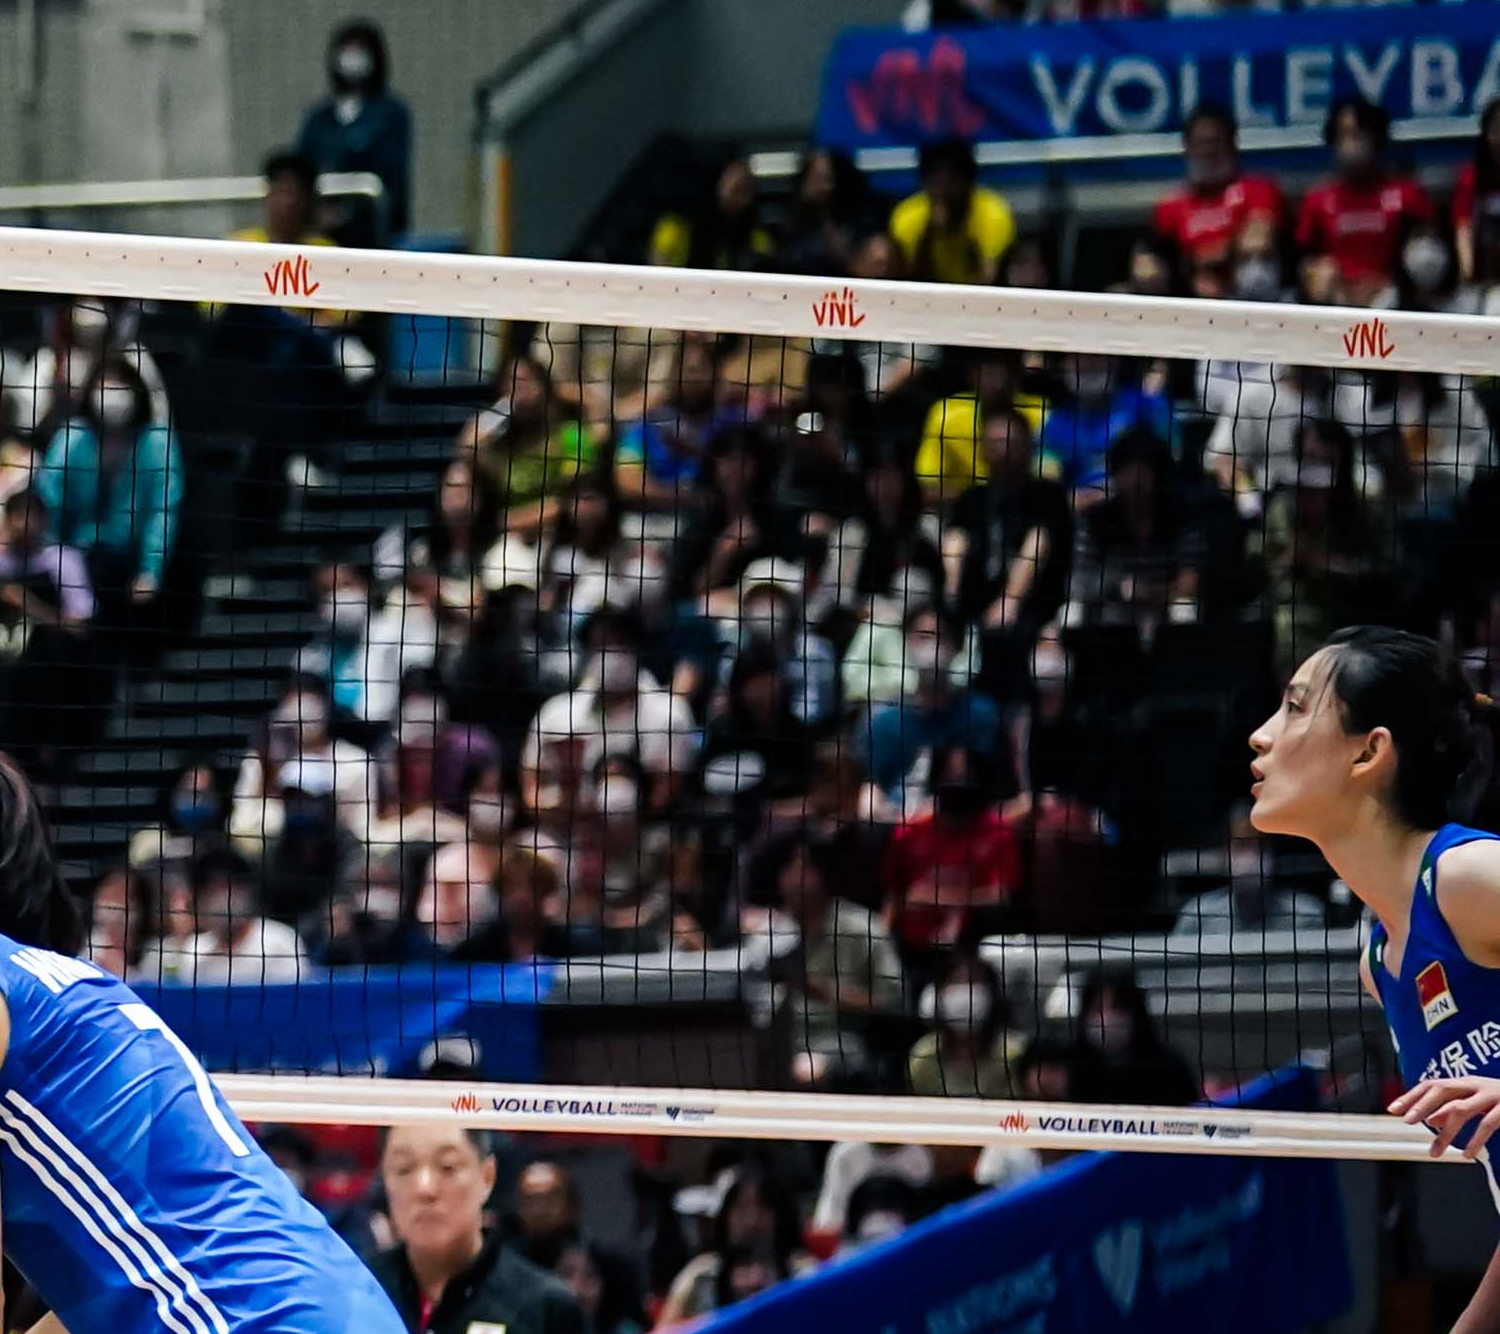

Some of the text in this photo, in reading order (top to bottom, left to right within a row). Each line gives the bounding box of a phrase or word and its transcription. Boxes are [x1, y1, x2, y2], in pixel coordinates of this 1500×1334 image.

[264, 254, 320, 297] VNL
[812, 285, 866, 328] VNL
[1343, 317, 1396, 358] VNL
[491, 1097, 618, 1116] VOLLEYBALL
[1038, 1116, 1160, 1136] VOLLEYBALL
